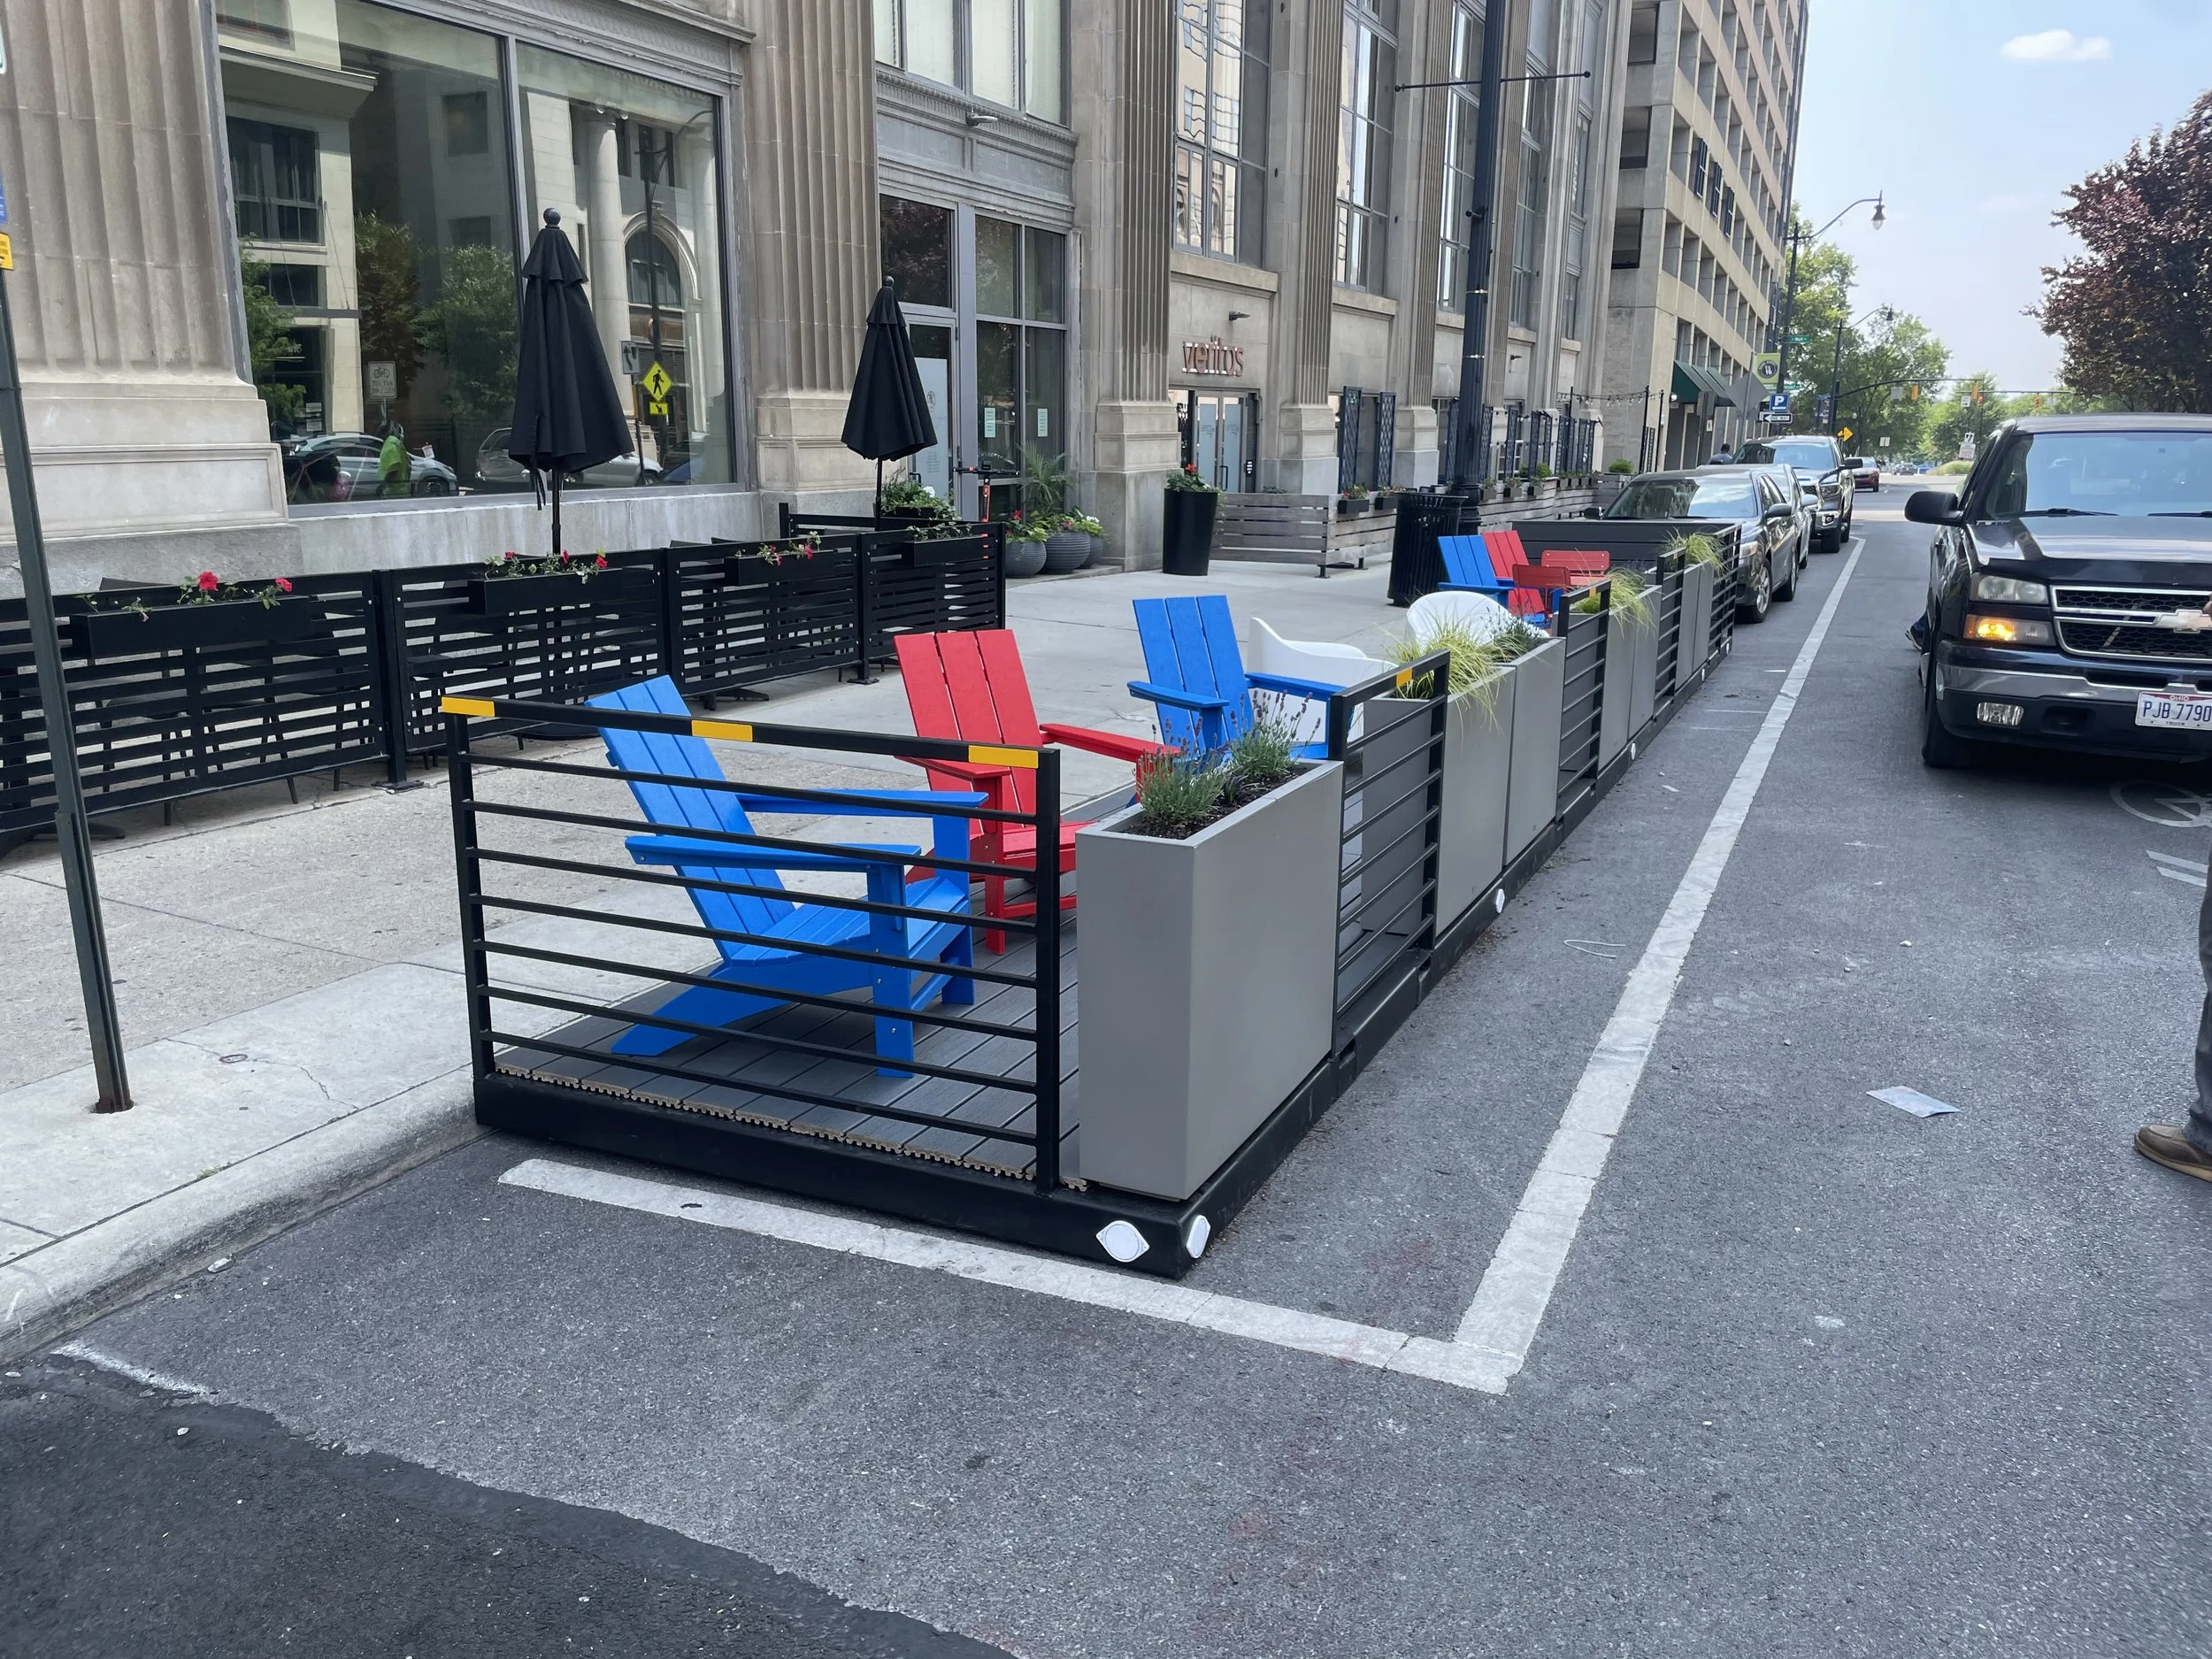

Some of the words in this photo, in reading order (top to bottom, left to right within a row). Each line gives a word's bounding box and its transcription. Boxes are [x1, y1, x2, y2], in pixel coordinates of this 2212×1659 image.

[1774, 396, 1785, 406] P
[2142, 701, 2170, 718] PJB
[2175, 703, 2212, 722] 7790
